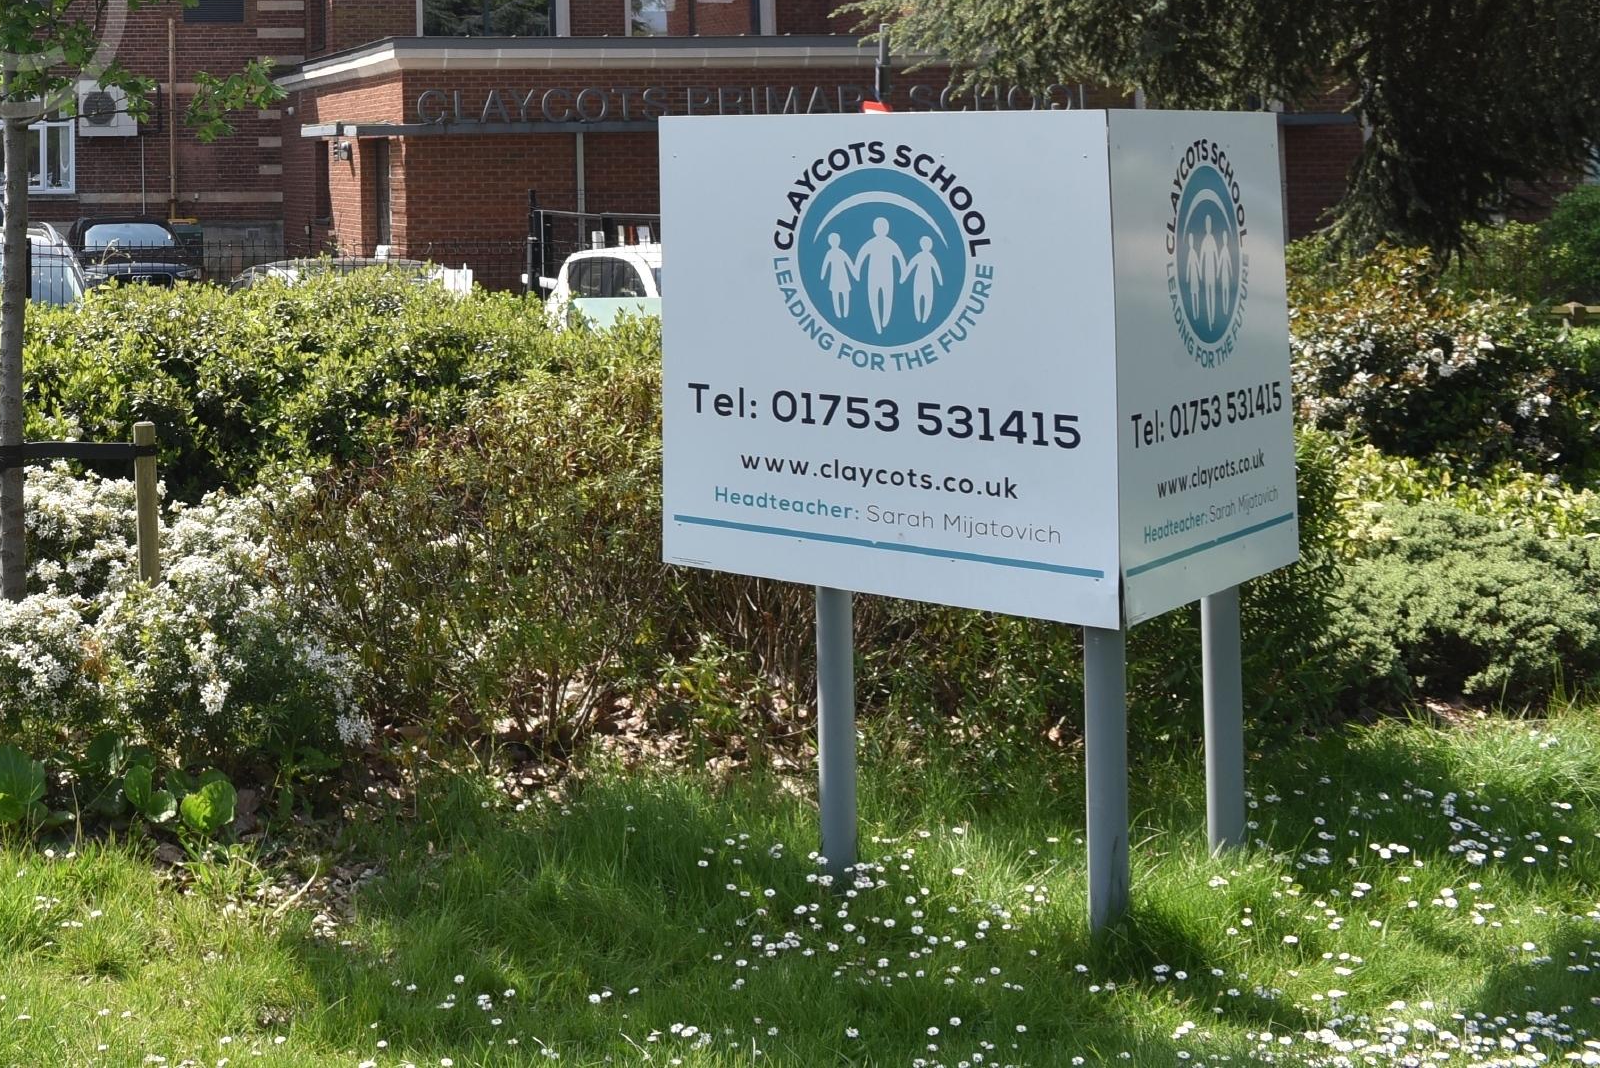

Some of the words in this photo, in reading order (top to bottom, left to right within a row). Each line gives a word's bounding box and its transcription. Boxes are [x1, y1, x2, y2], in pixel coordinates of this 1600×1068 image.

[417, 87, 670, 124] CLAYCOTS
[687, 85, 893, 113] PRIMAR
[774, 140, 886, 251] CLAYCOTS
[893, 144, 991, 258] SCHOOL
[1165, 138, 1209, 256] CLAYCOTS
[1210, 142, 1248, 248] SCHOOL
[773, 256, 835, 351] LEADING
[837, 343, 886, 372] FOR
[890, 343, 938, 372] THE
[937, 263, 994, 354] FUTURE
[1166, 261, 1195, 356] LEADING
[1195, 345, 1215, 369] FOR
[1215, 335, 1235, 365] THE
[1232, 254, 1250, 342] FUTURE
[687, 382, 757, 419] Tel:
[772, 390, 900, 433] 01753
[917, 402, 1082, 450] 531415
[1131, 409, 1165, 449] Tel:
[1169, 394, 1222, 439] 01753
[1226, 381, 1282, 424] 531415
[740, 453, 1019, 500] www.claycots.co.uk
[1157, 448, 1265, 499] www.claycots.co.uk
[714, 485, 861, 520] Headteacher:
[865, 503, 934, 530] Sarah
[943, 513, 1062, 545] Mijatovich
[1143, 511, 1208, 544] Headteacher:
[1209, 499, 1236, 523] Sarah
[1237, 486, 1279, 515] Mijatovich
